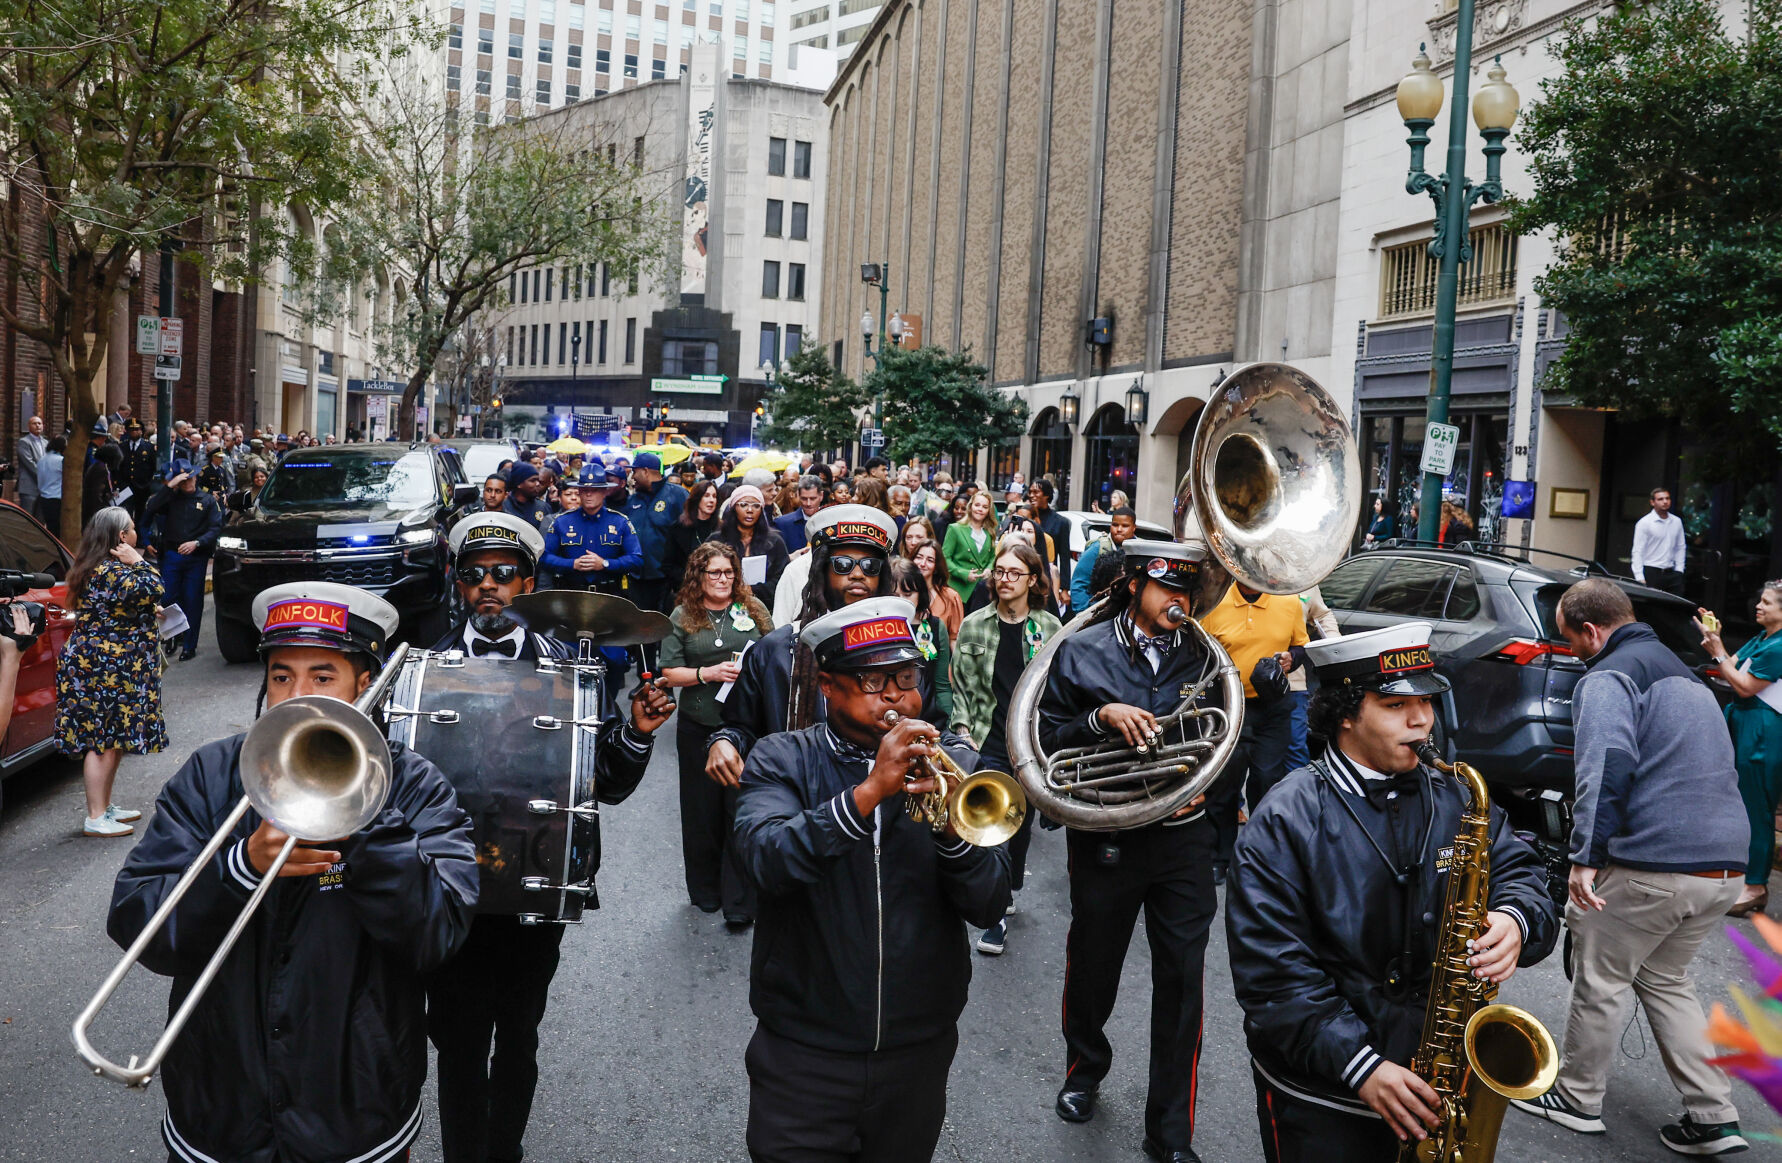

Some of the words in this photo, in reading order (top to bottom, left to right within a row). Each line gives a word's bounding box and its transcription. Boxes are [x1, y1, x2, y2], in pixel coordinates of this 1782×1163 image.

[1515, 446, 1528, 456] 123
[1428, 456, 1446, 465] PARK
[468, 527, 517, 541] KINFOLK
[840, 524, 885, 542] KINFOLK
[267, 605, 343, 626] KINFOLK
[847, 622, 906, 645] KINFOLK
